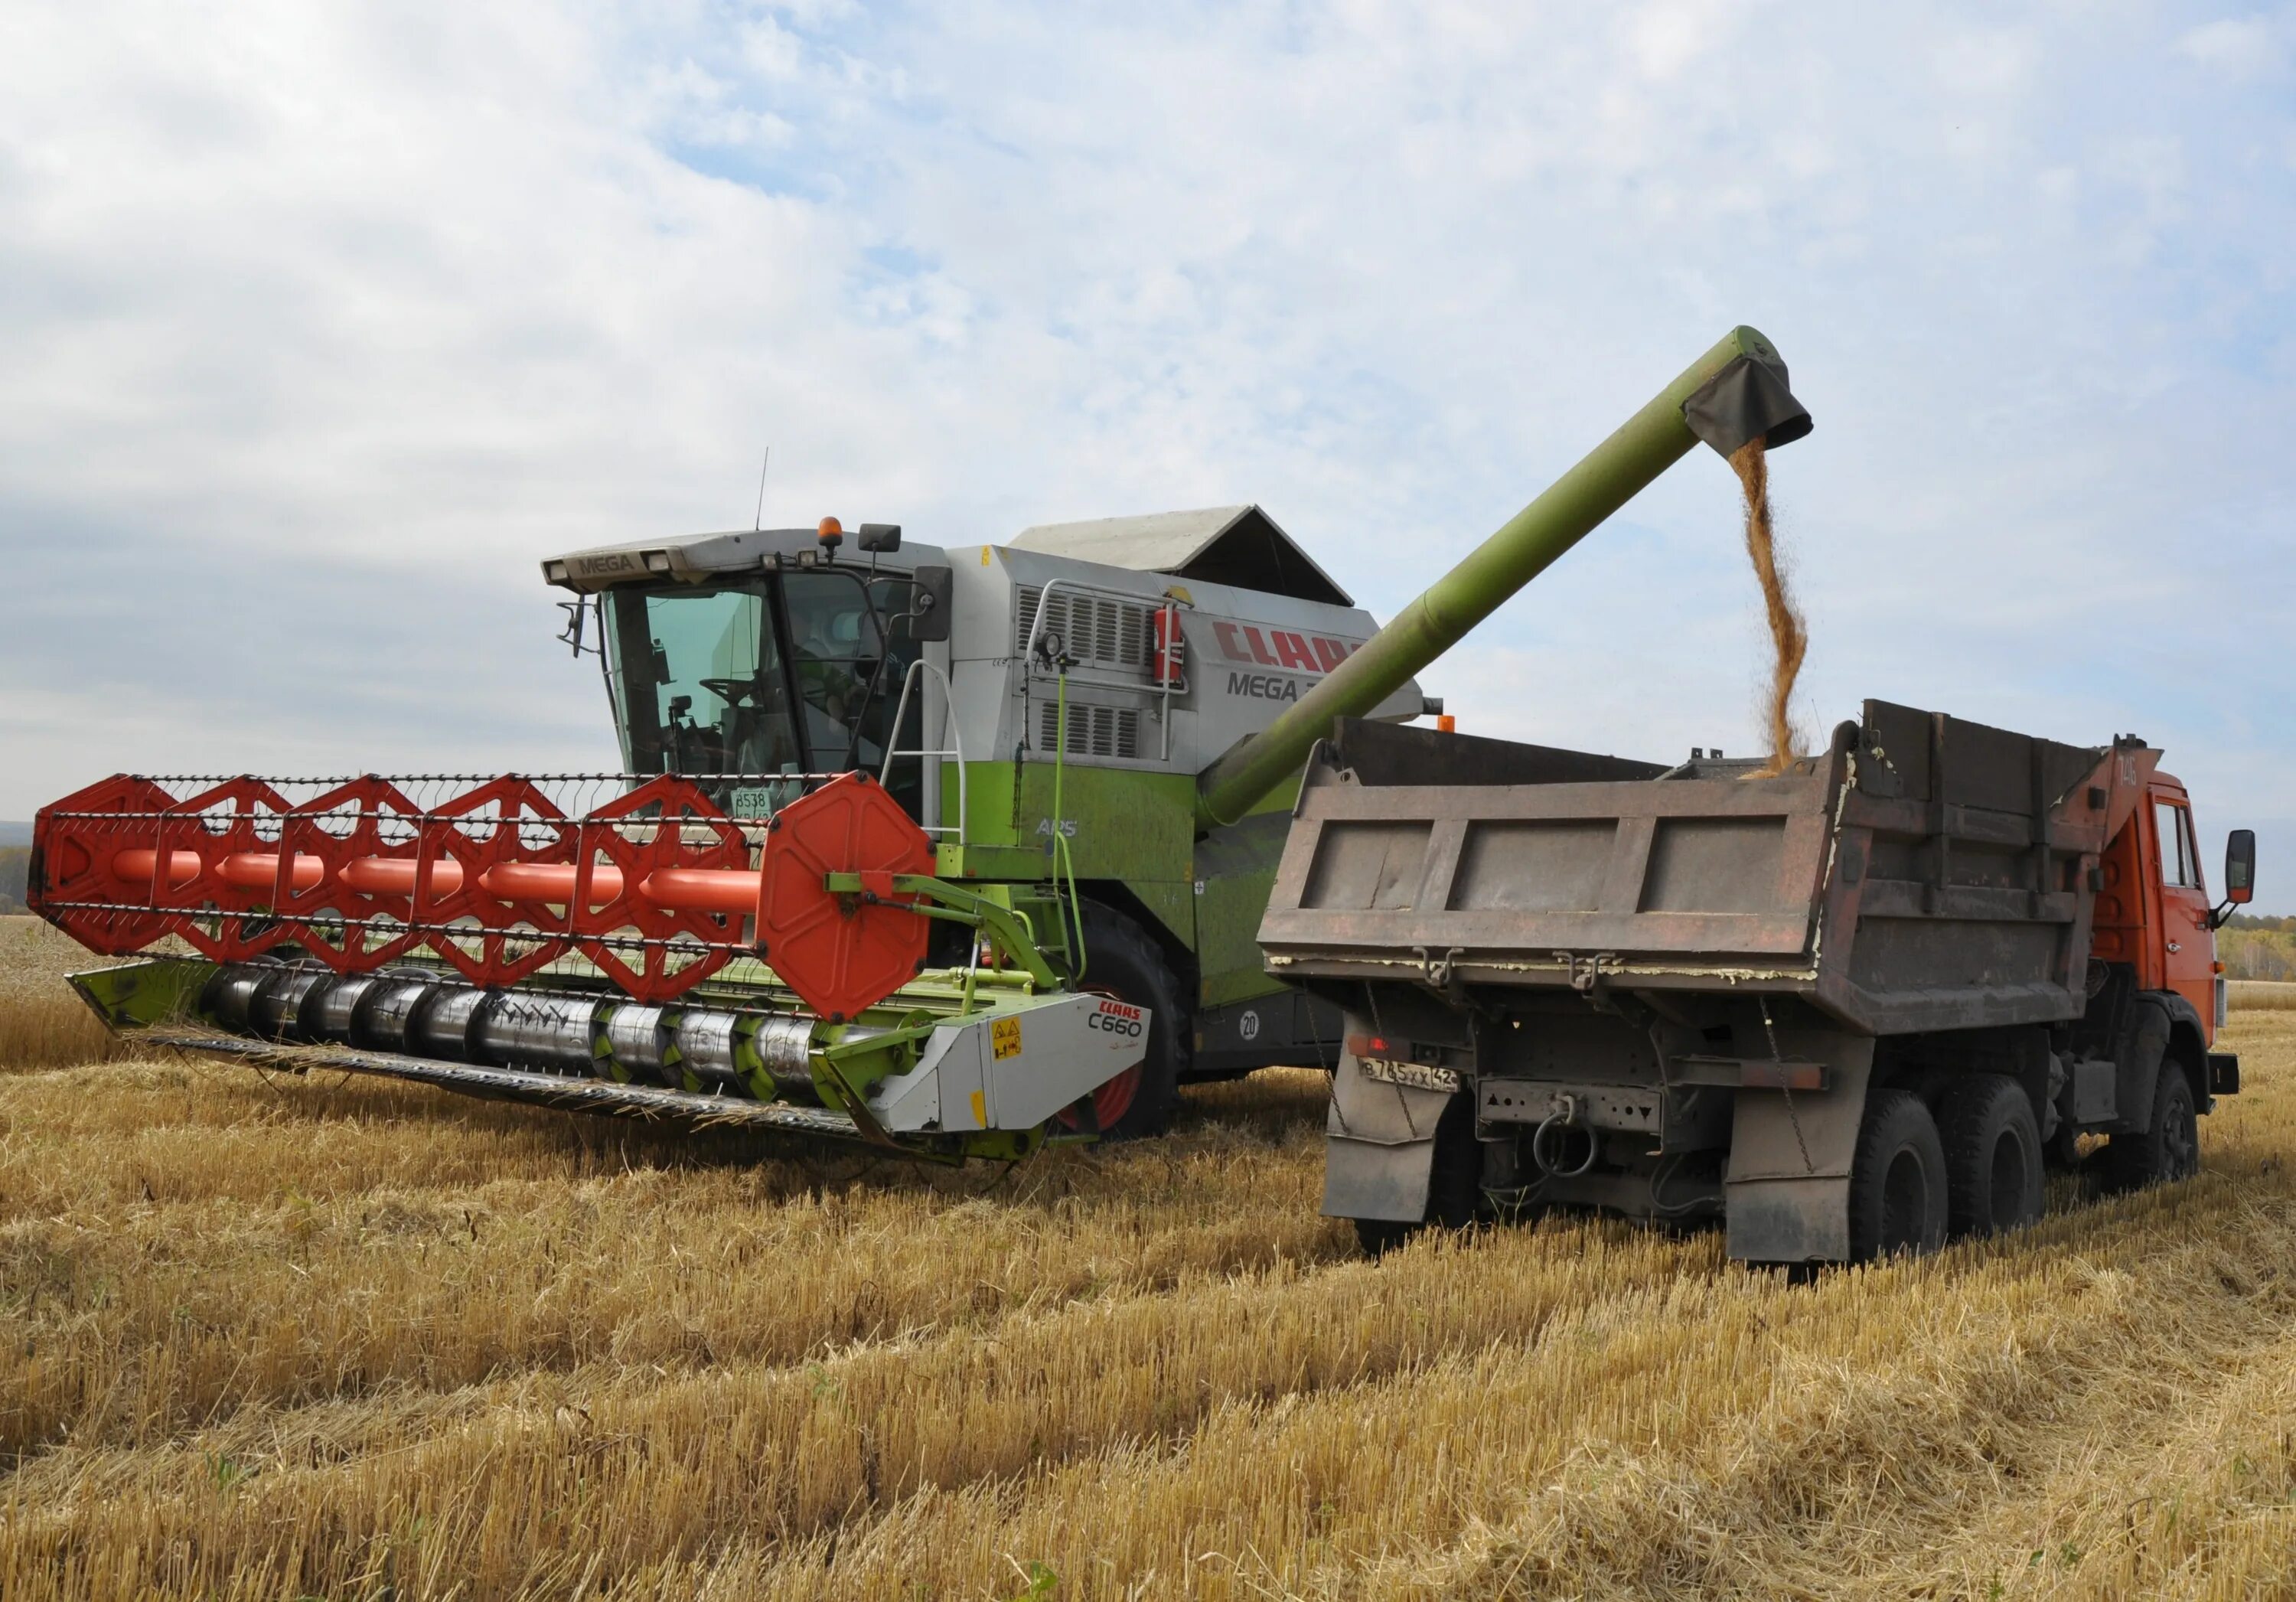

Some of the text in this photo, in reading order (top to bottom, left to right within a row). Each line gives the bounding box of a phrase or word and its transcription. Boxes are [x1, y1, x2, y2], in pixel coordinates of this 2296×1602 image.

[579, 555, 634, 575] MEGA
[1212, 622, 1361, 673] CLAA
[1227, 672, 1297, 702] MEGA
[1100, 1000, 1140, 1020] CLAAS
[1088, 1012, 1142, 1038] C660
[1244, 1016, 1256, 1036] 20
